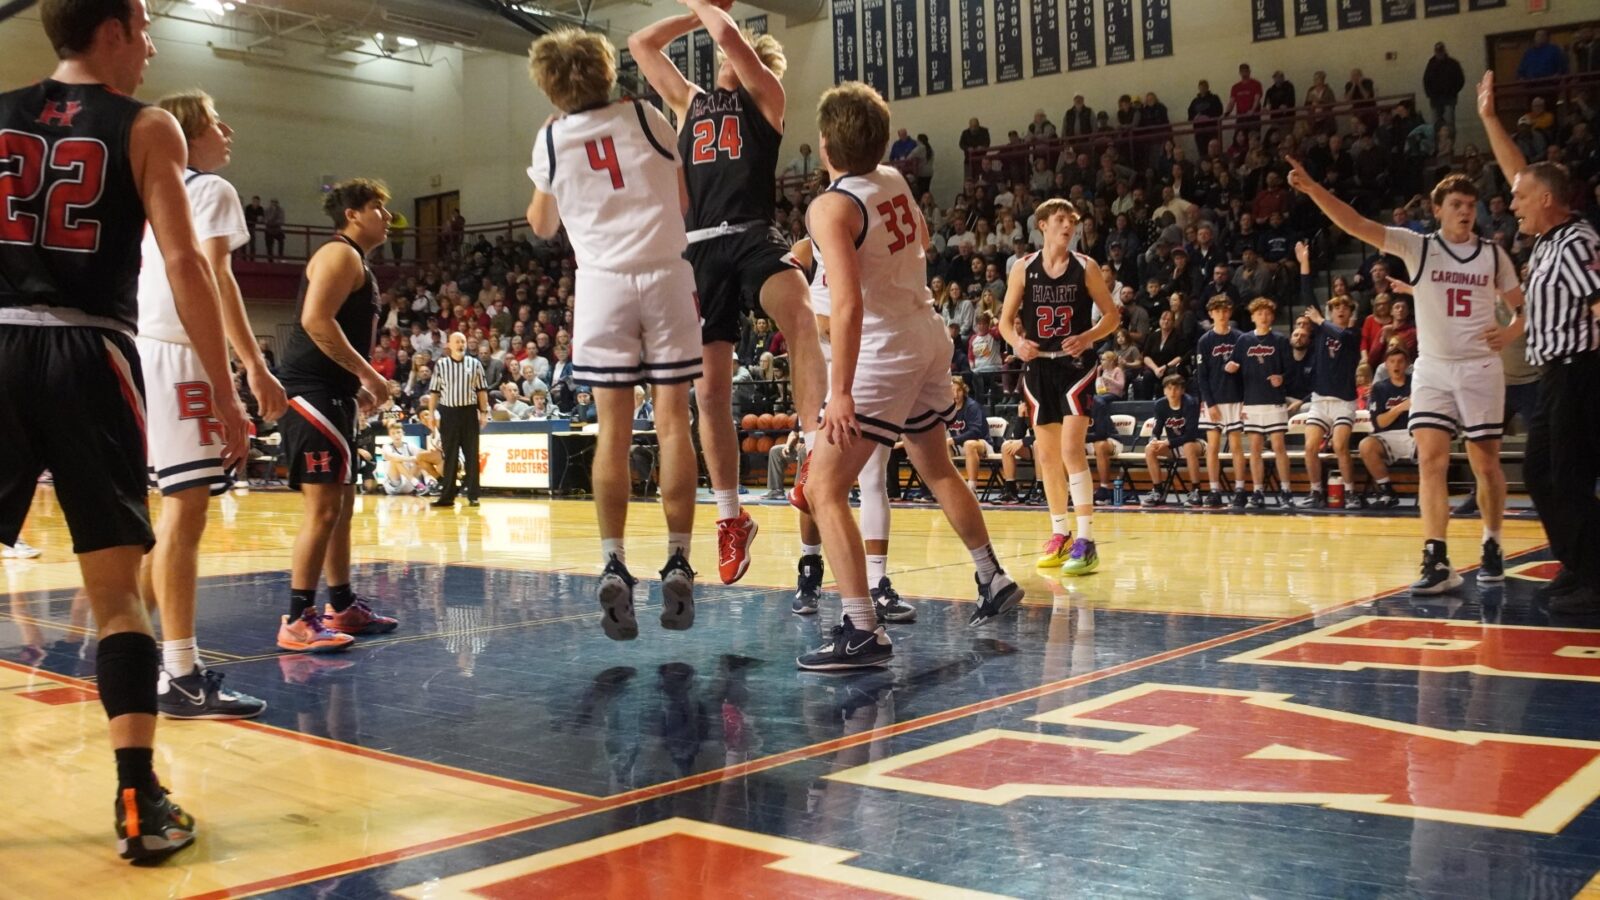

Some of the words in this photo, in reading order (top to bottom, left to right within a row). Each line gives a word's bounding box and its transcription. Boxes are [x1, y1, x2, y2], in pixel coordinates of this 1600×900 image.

[693, 115, 743, 165] 24
[585, 135, 625, 191] 4
[0, 128, 108, 253] 22
[876, 193, 917, 255] 33
[1032, 284, 1078, 303] HART
[1431, 270, 1489, 287] CARDINALS
[1446, 287, 1472, 317] 15
[1036, 305, 1074, 338] 23
[505, 461, 549, 474] BOOSTERS
[507, 448, 549, 461] SPORTS
